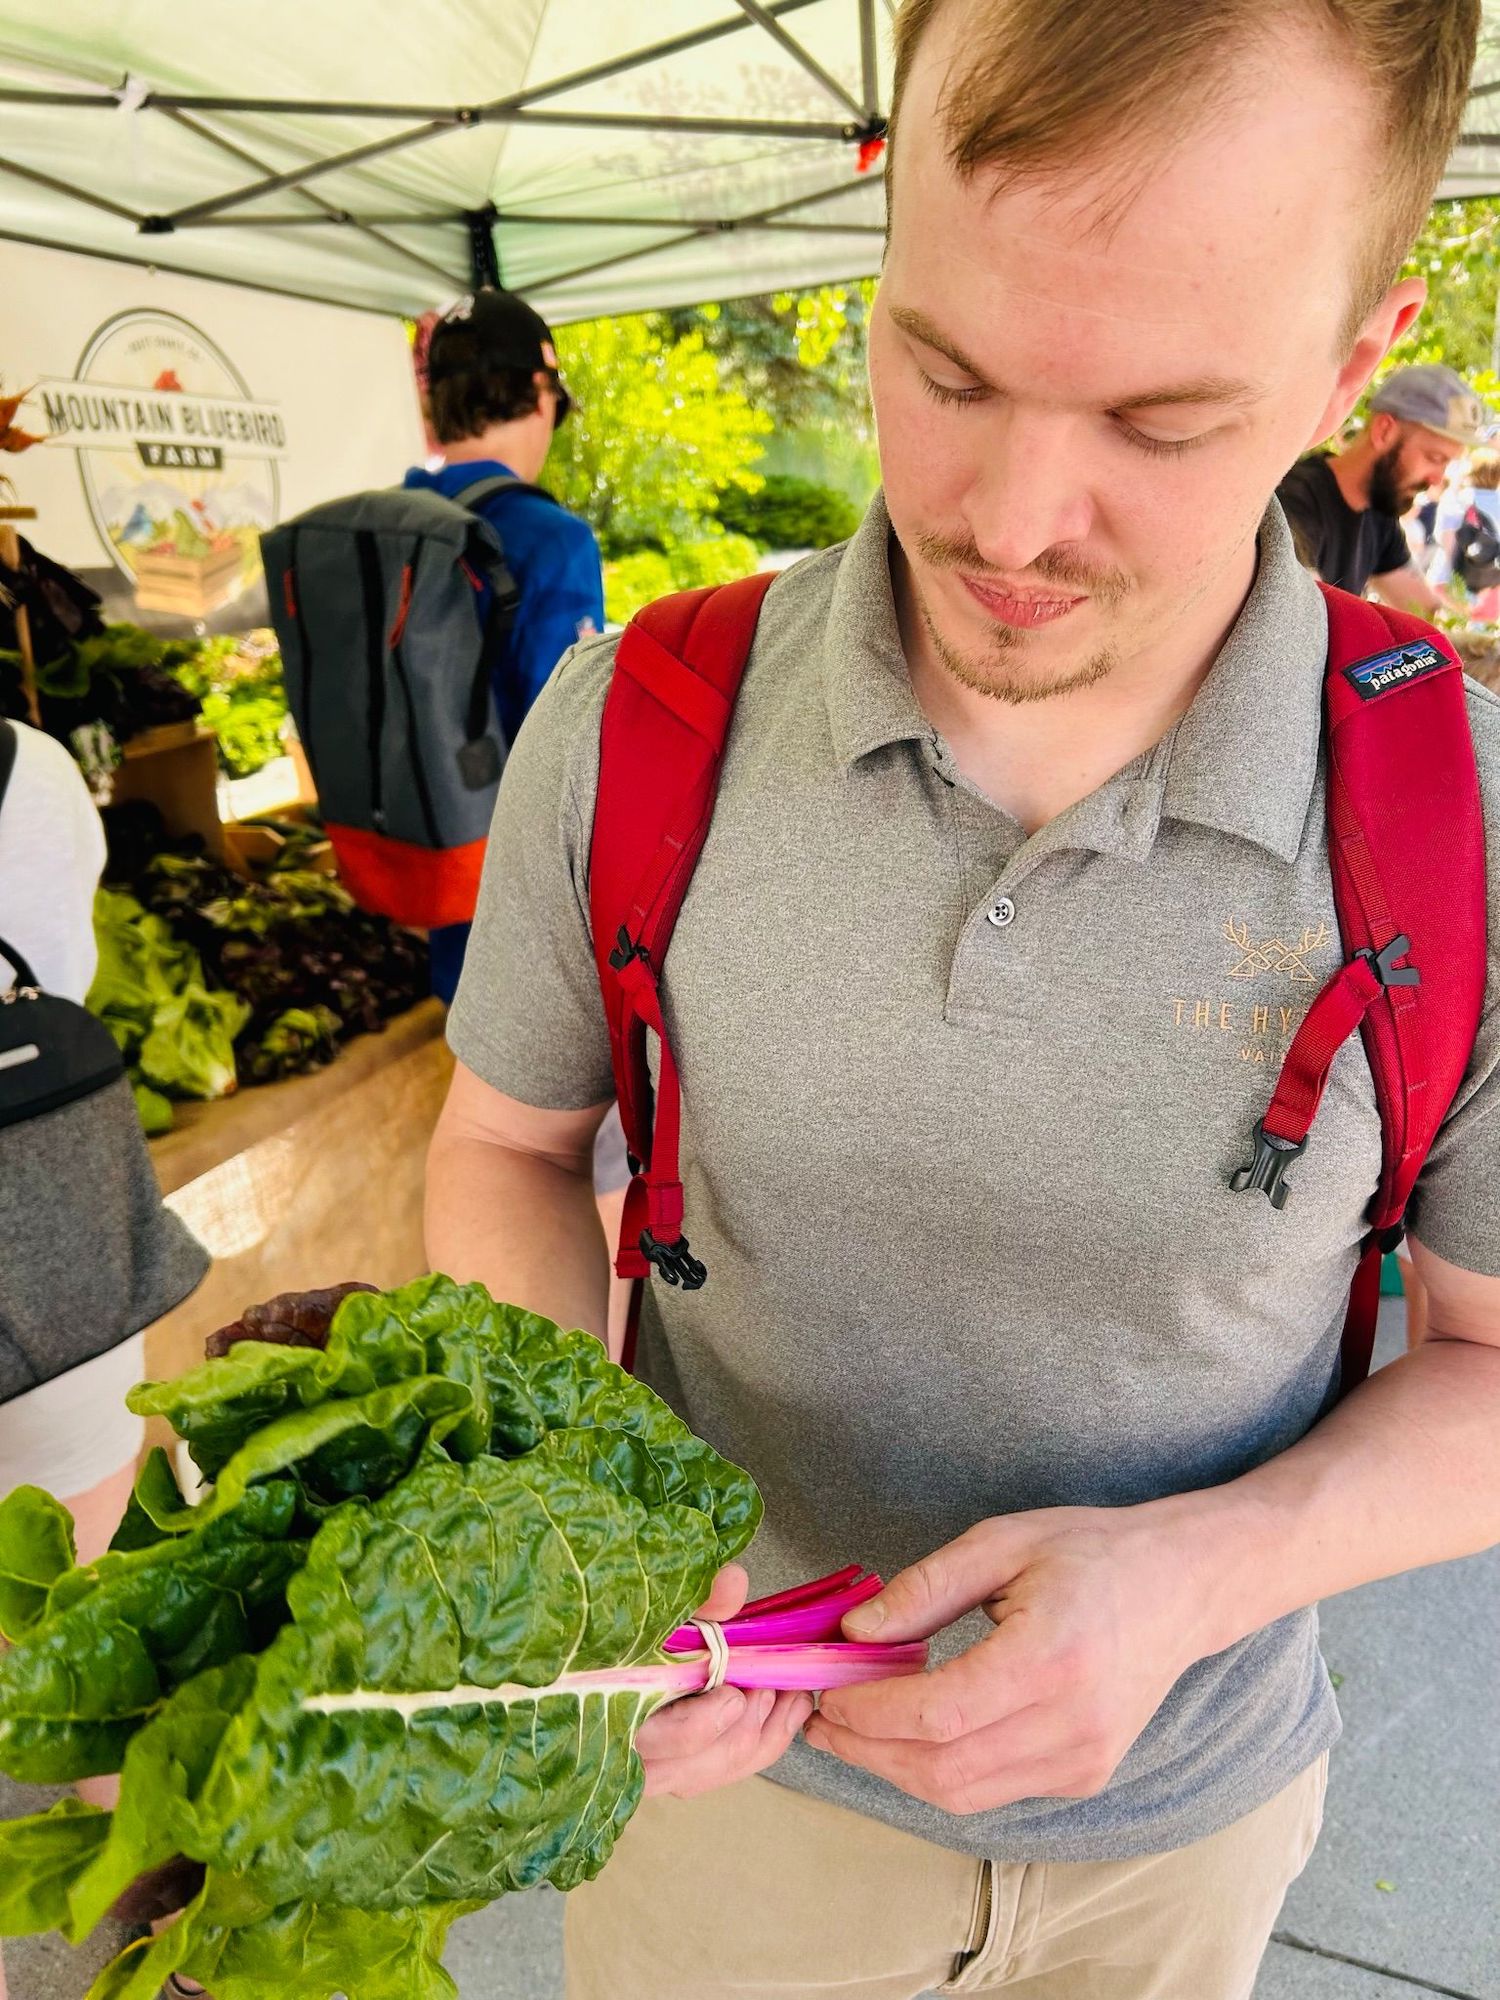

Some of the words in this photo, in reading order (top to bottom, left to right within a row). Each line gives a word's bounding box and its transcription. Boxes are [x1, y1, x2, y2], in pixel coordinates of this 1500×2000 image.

[42, 391, 173, 434] MOUNTAIN
[181, 404, 286, 447] BLUEBIRD
[148, 443, 216, 467] FARM
[1370, 655, 1438, 690] patagonia
[1173, 999, 1233, 1029] THE
[1253, 1004, 1309, 1033] HY
